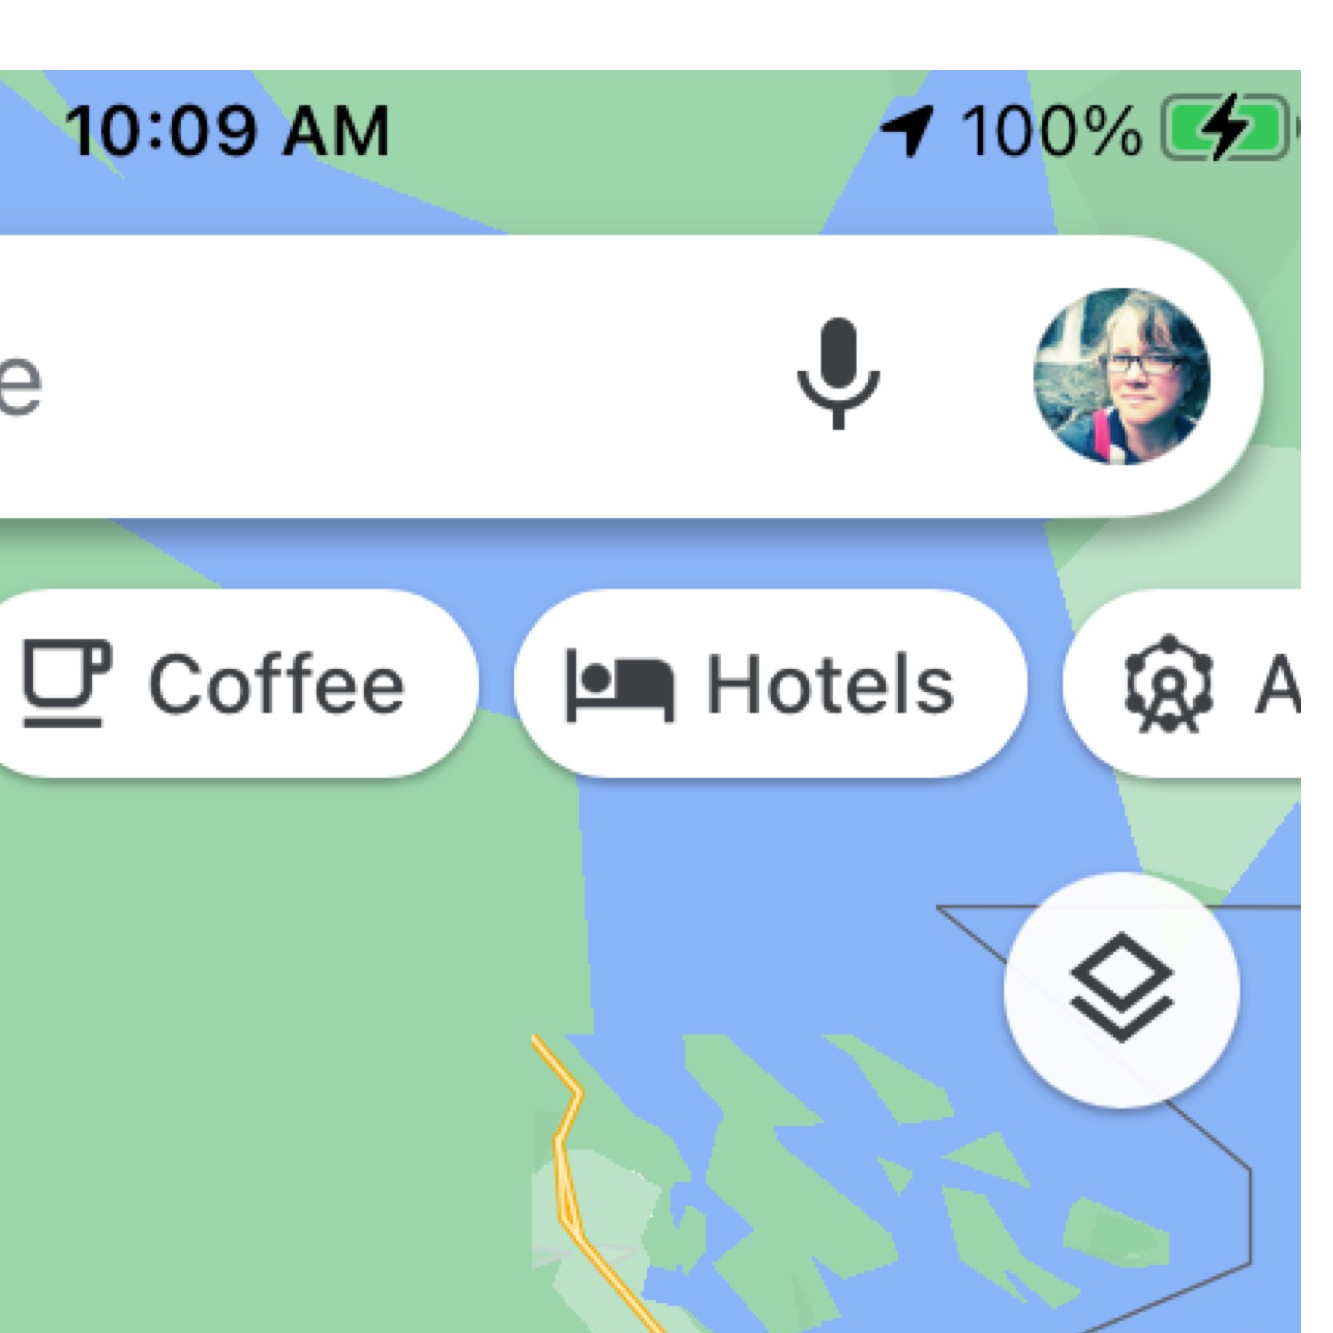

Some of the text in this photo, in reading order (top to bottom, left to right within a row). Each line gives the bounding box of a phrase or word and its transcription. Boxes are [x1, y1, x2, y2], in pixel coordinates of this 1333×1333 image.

[66, 104, 388, 157] 10:09 AM
[964, 104, 1143, 157] 100%
[150, 650, 403, 715] Coffee
[710, 651, 954, 714] Hotels
